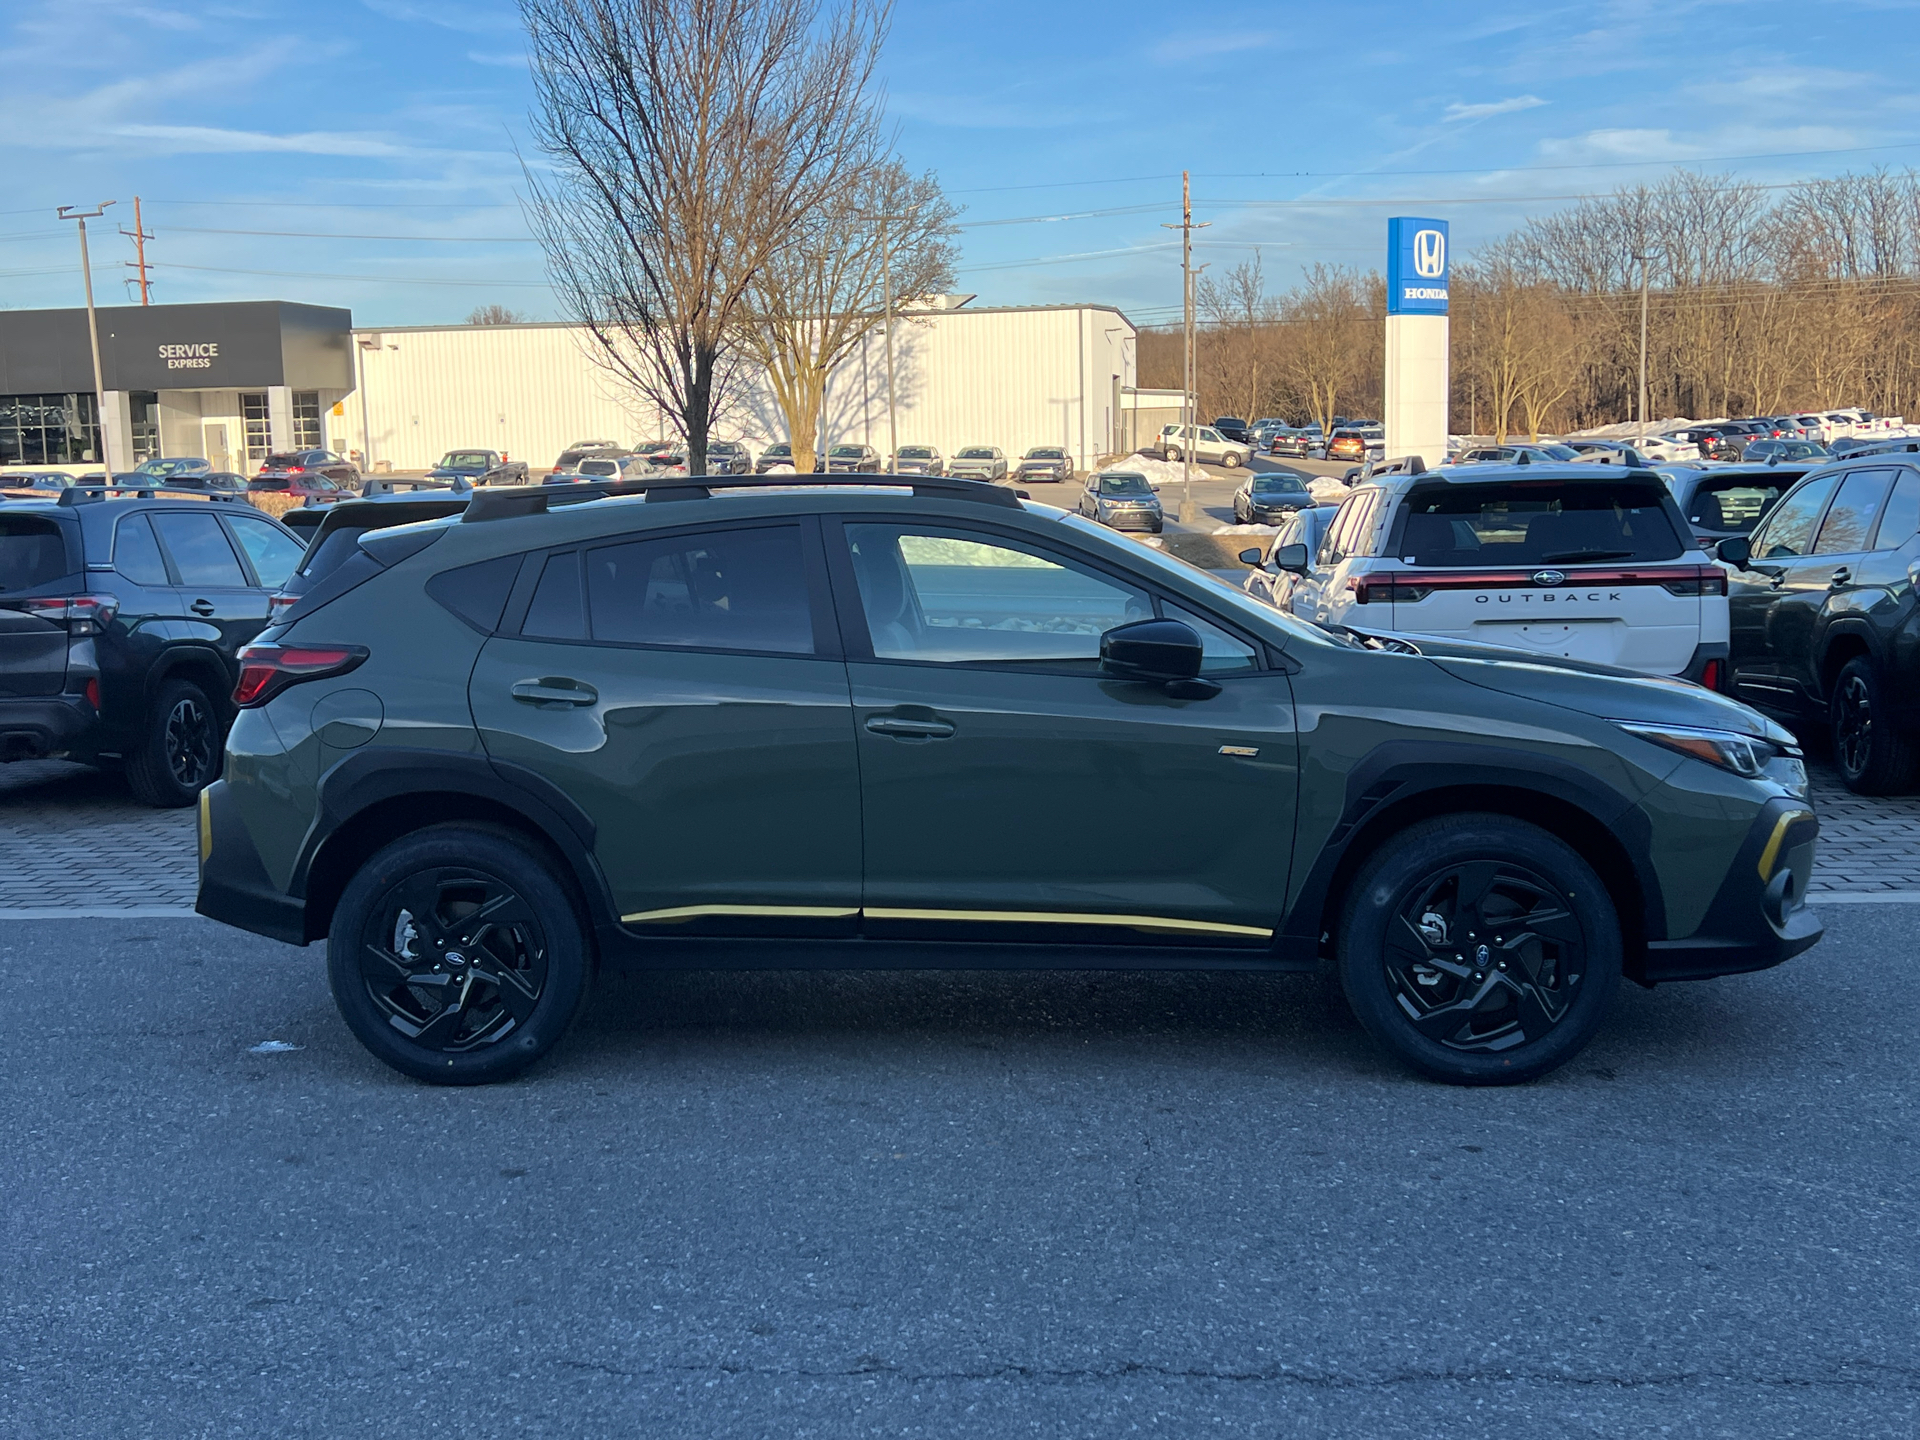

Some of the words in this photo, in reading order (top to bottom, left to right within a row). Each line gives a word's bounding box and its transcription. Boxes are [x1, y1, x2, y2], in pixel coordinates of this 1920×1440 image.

[1404, 288, 1449, 300] HONDA
[158, 343, 219, 358] SERVICE
[167, 358, 211, 369] EXPRESS
[1474, 592, 1622, 603] OUTBACK
